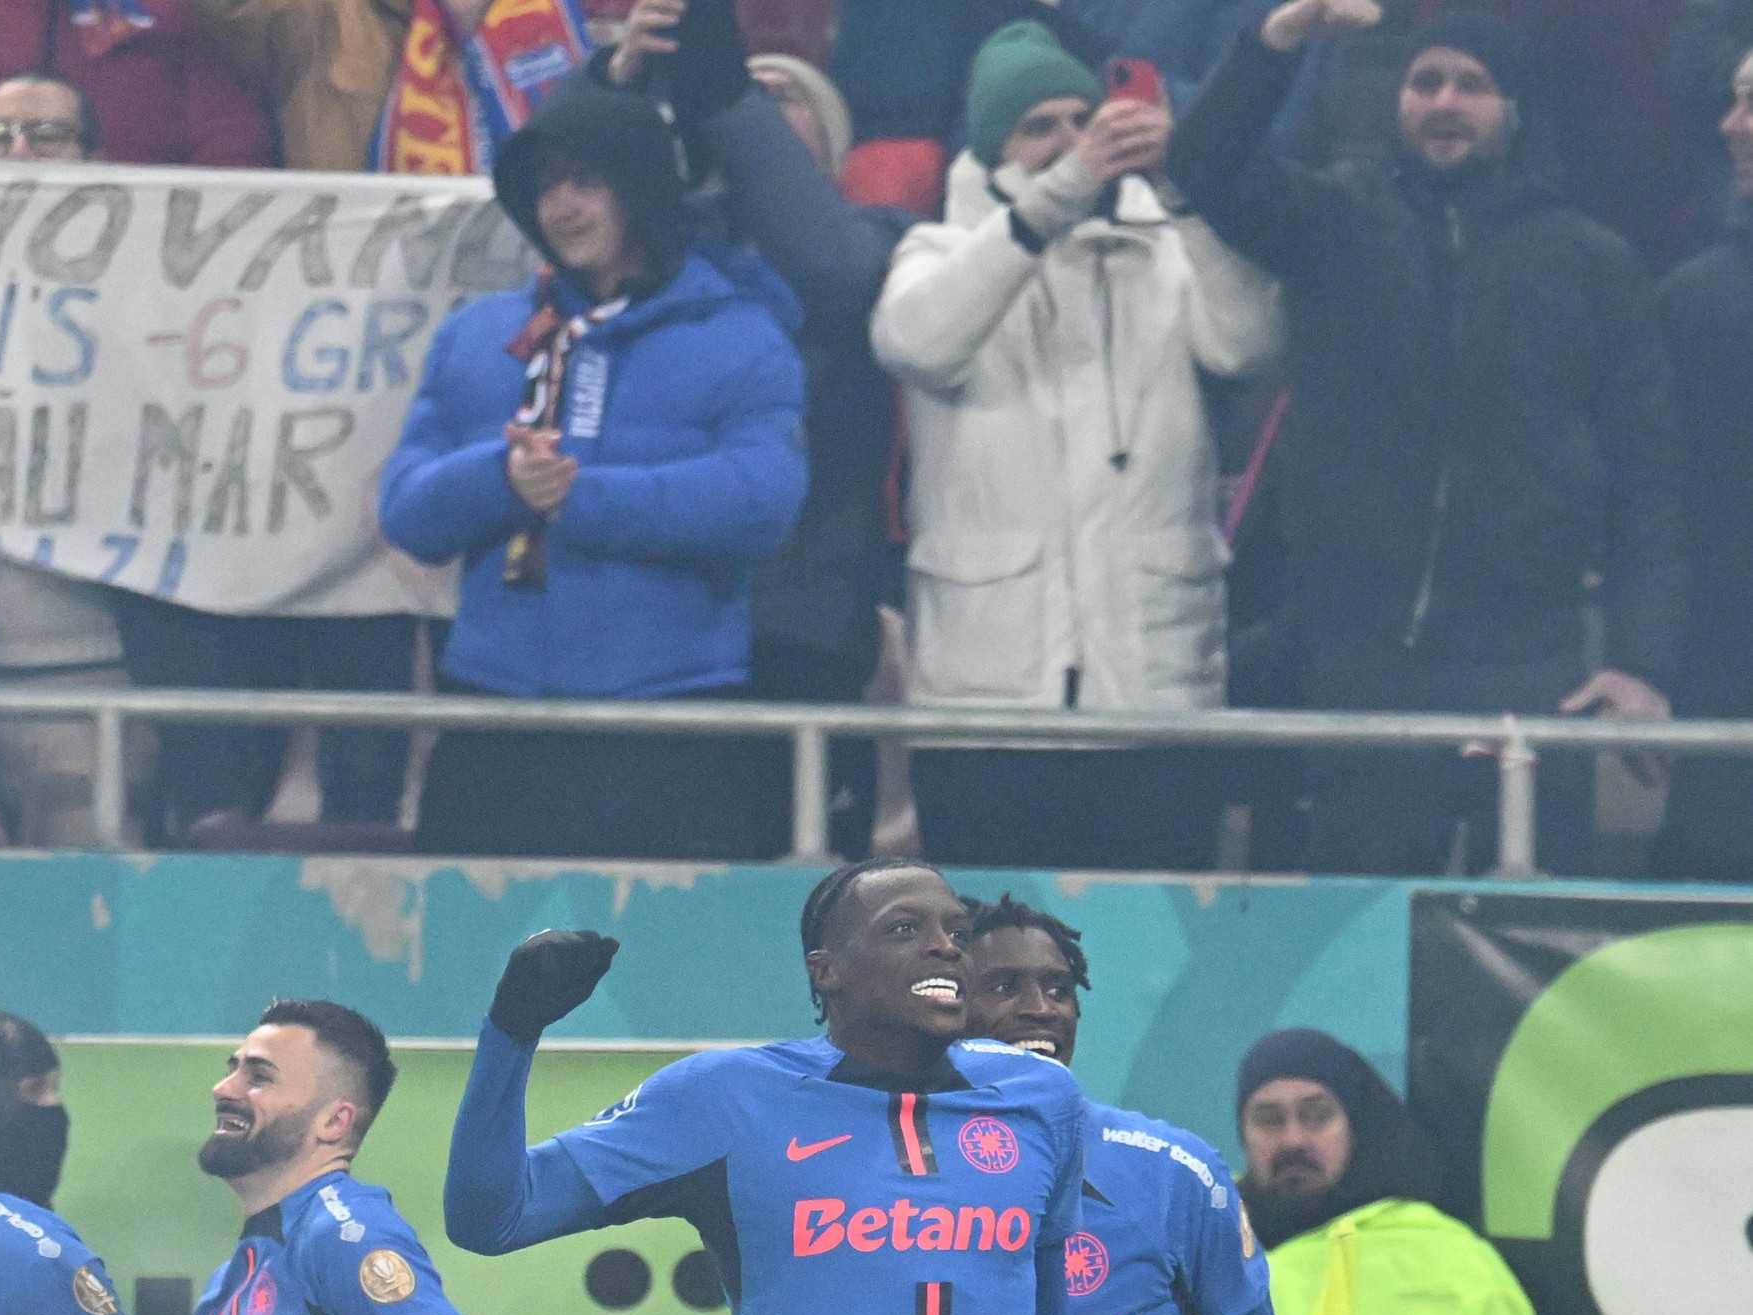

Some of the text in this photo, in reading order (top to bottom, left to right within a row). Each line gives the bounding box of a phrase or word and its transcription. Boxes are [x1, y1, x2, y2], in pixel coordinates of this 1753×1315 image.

[148, 297, 248, 390] -6
[281, 299, 436, 393] GR
[793, 1198, 1031, 1257] Betano
